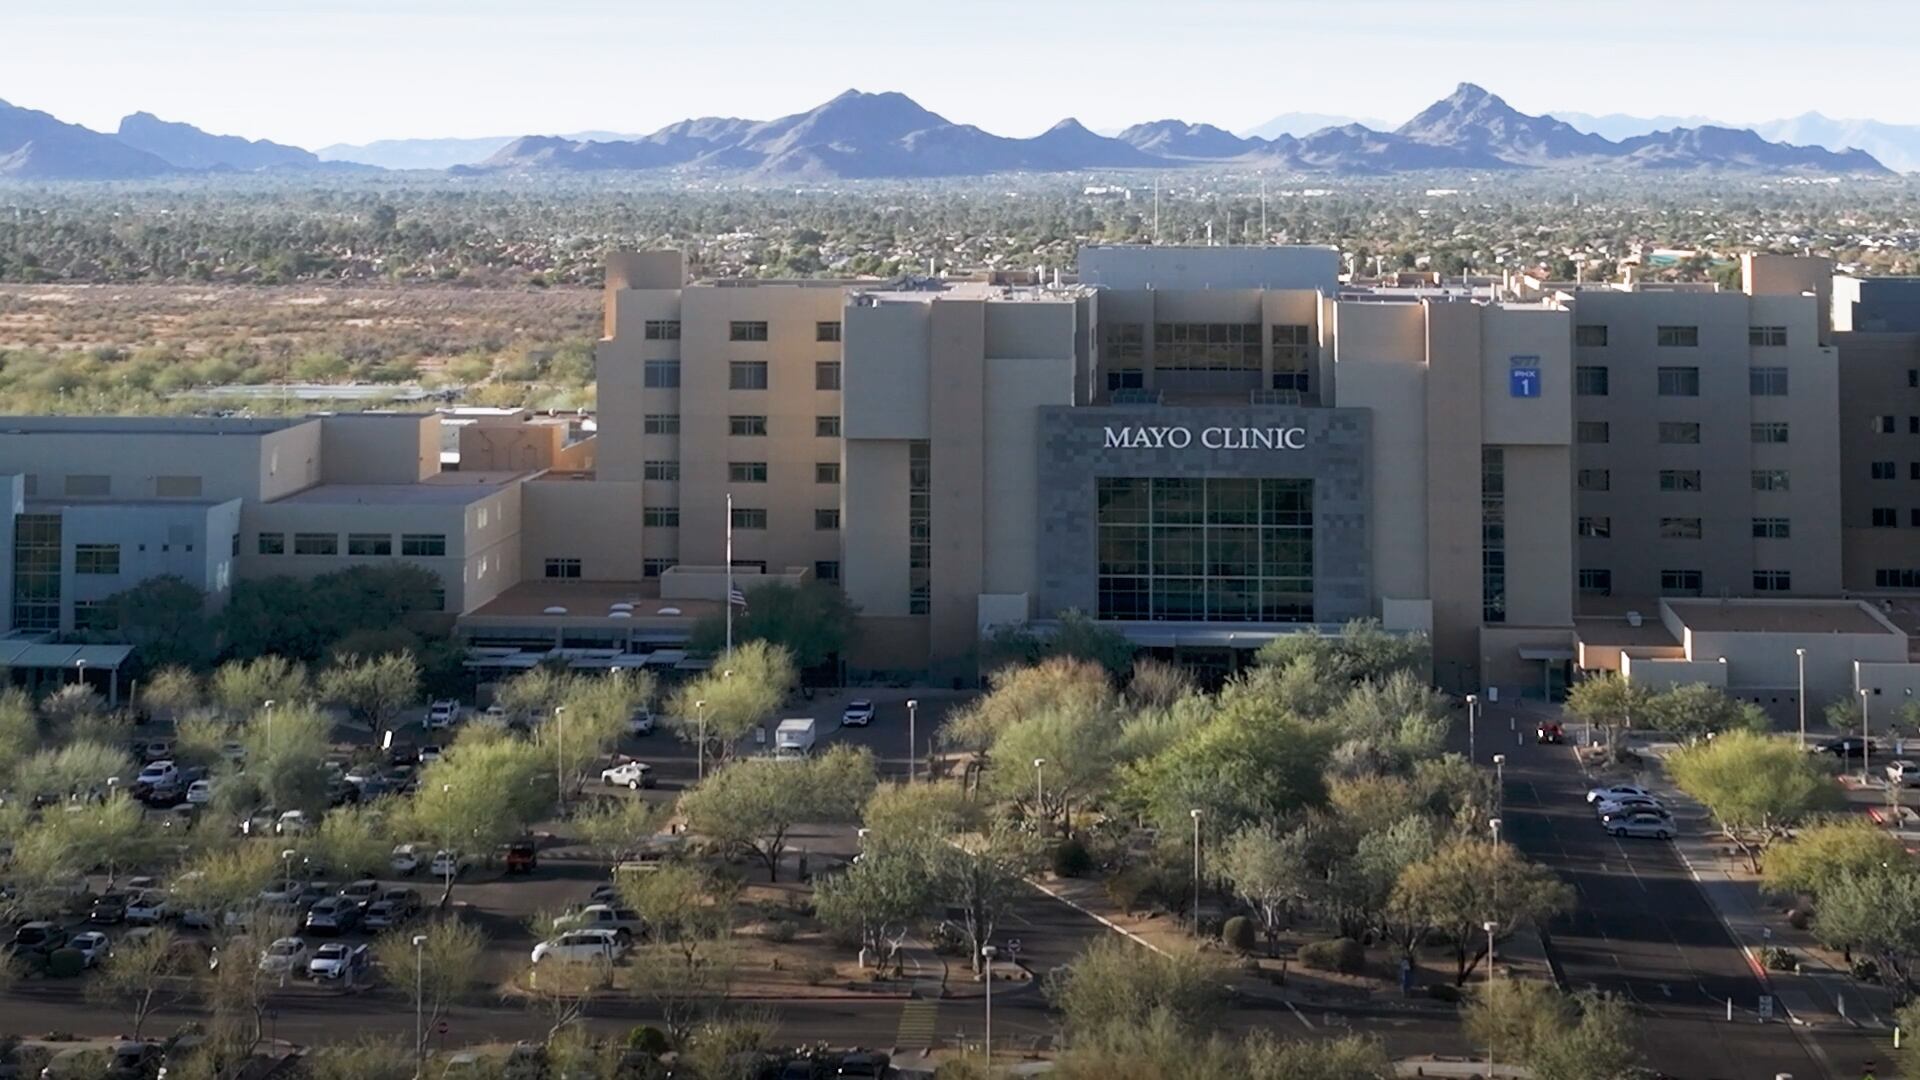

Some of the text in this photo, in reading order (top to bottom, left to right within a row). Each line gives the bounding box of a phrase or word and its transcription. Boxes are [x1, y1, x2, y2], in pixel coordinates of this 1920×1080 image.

[1521, 378, 1529, 395] 1
[1103, 426, 1306, 450] MAYO CLINIC
